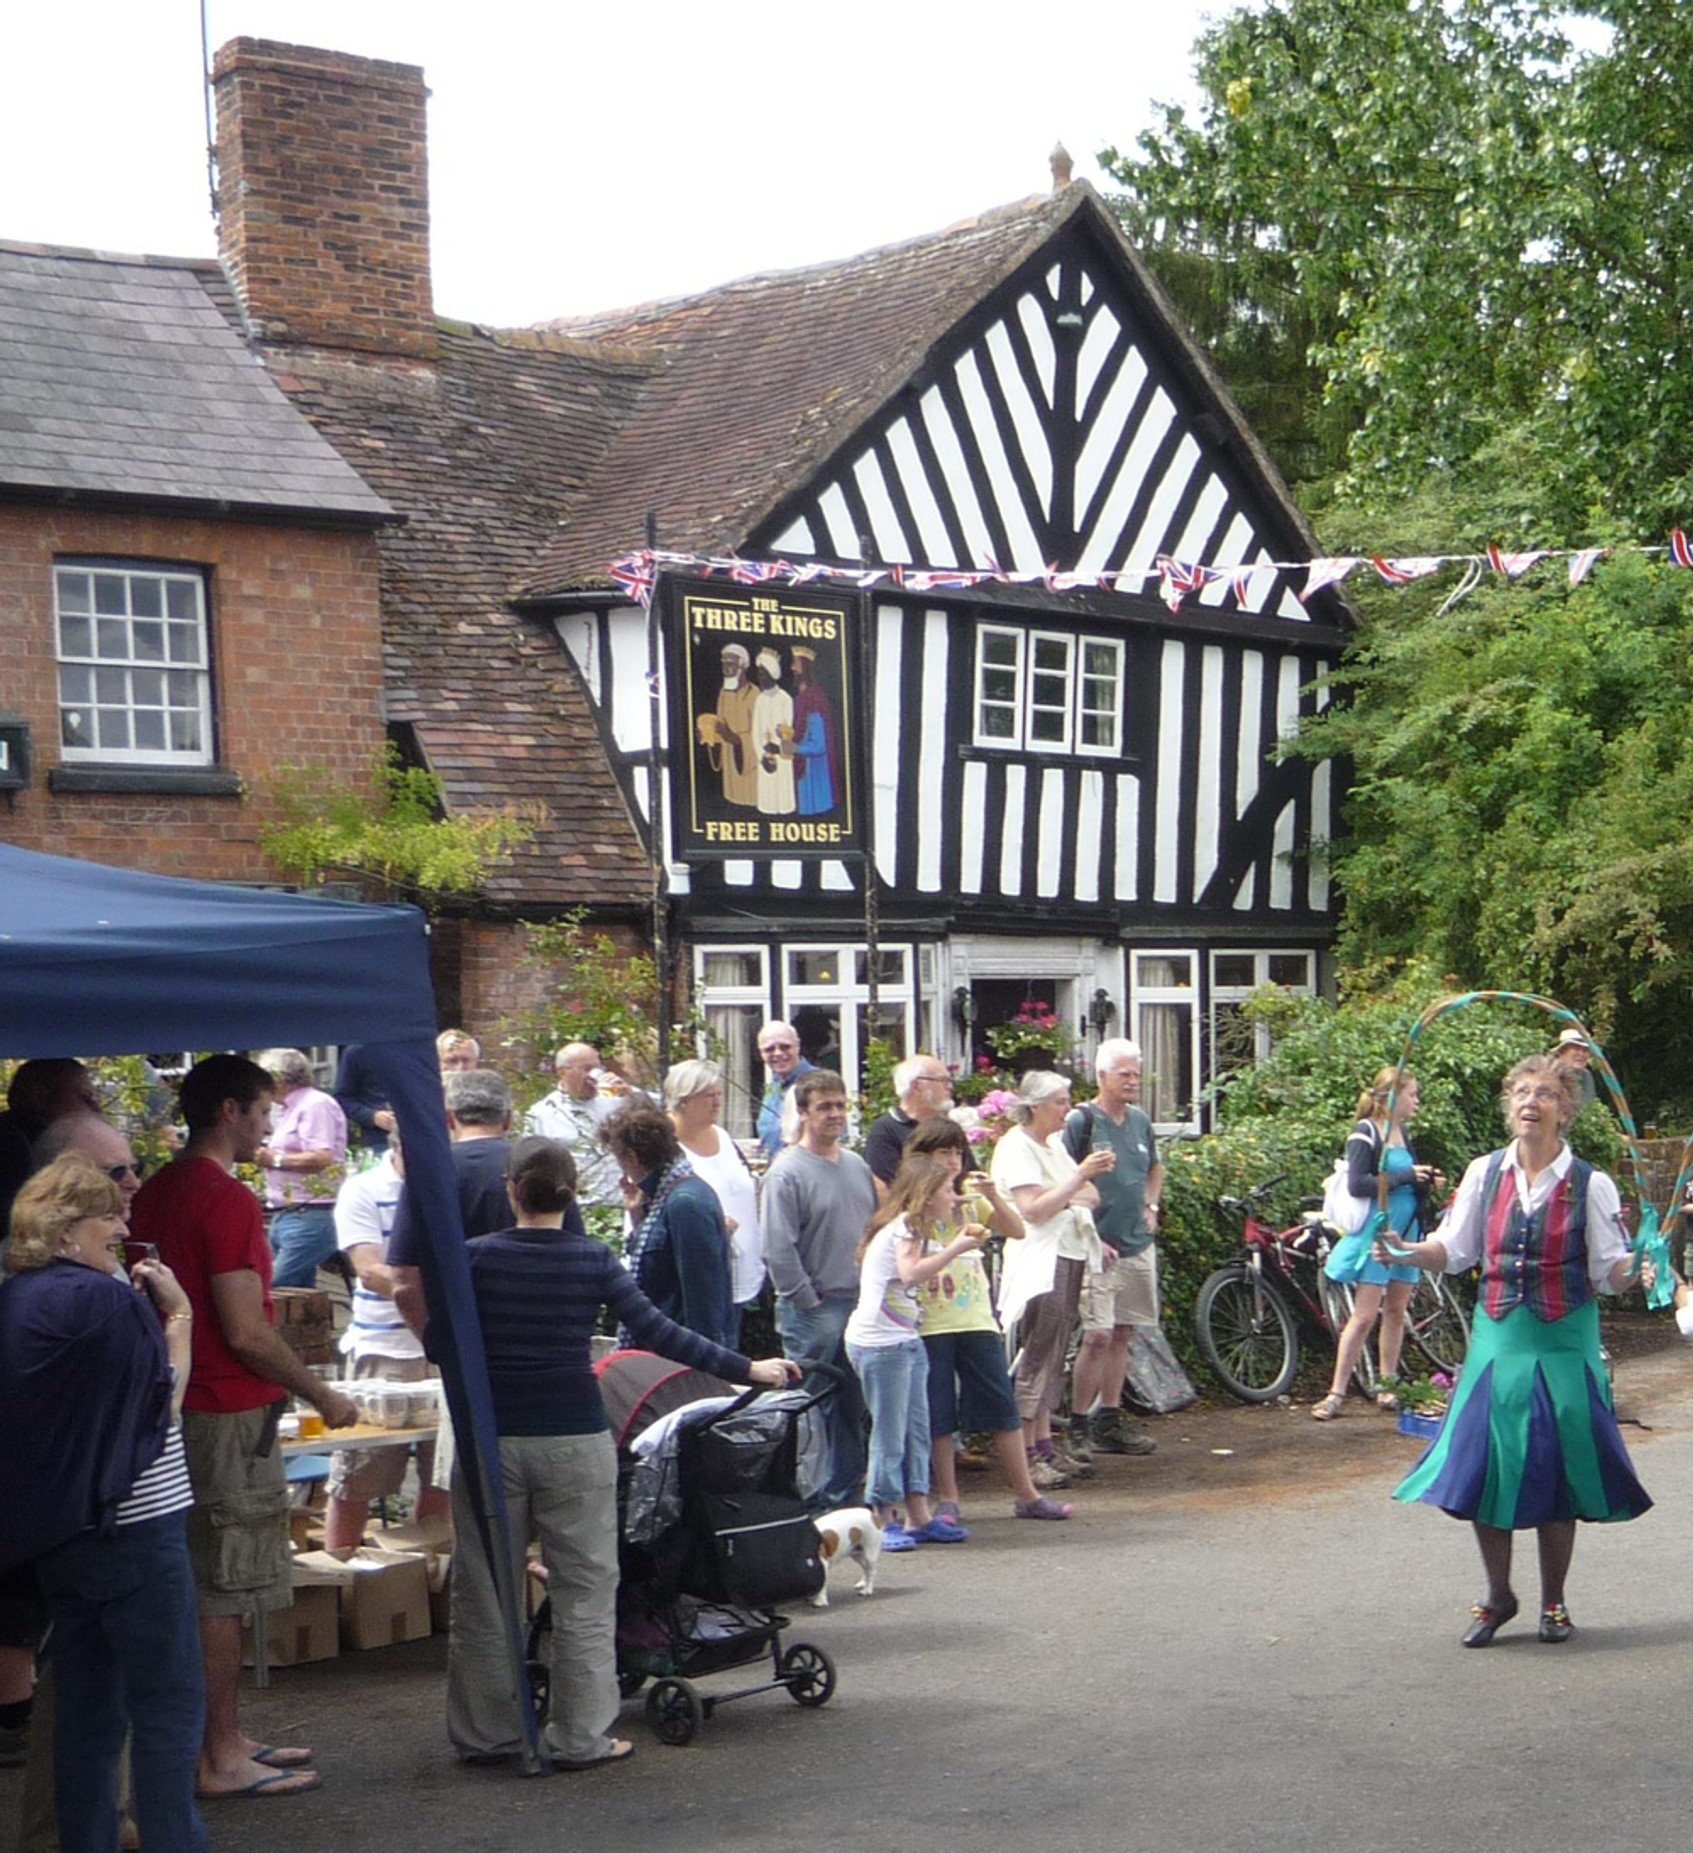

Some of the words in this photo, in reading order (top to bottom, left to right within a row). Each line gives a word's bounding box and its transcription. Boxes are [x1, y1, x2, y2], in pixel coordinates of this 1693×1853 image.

[751, 597, 779, 612] THE
[691, 606, 765, 633] THREE
[770, 614, 836, 640] KINGS
[705, 821, 760, 841] FREE
[769, 822, 841, 842] HOUSE
